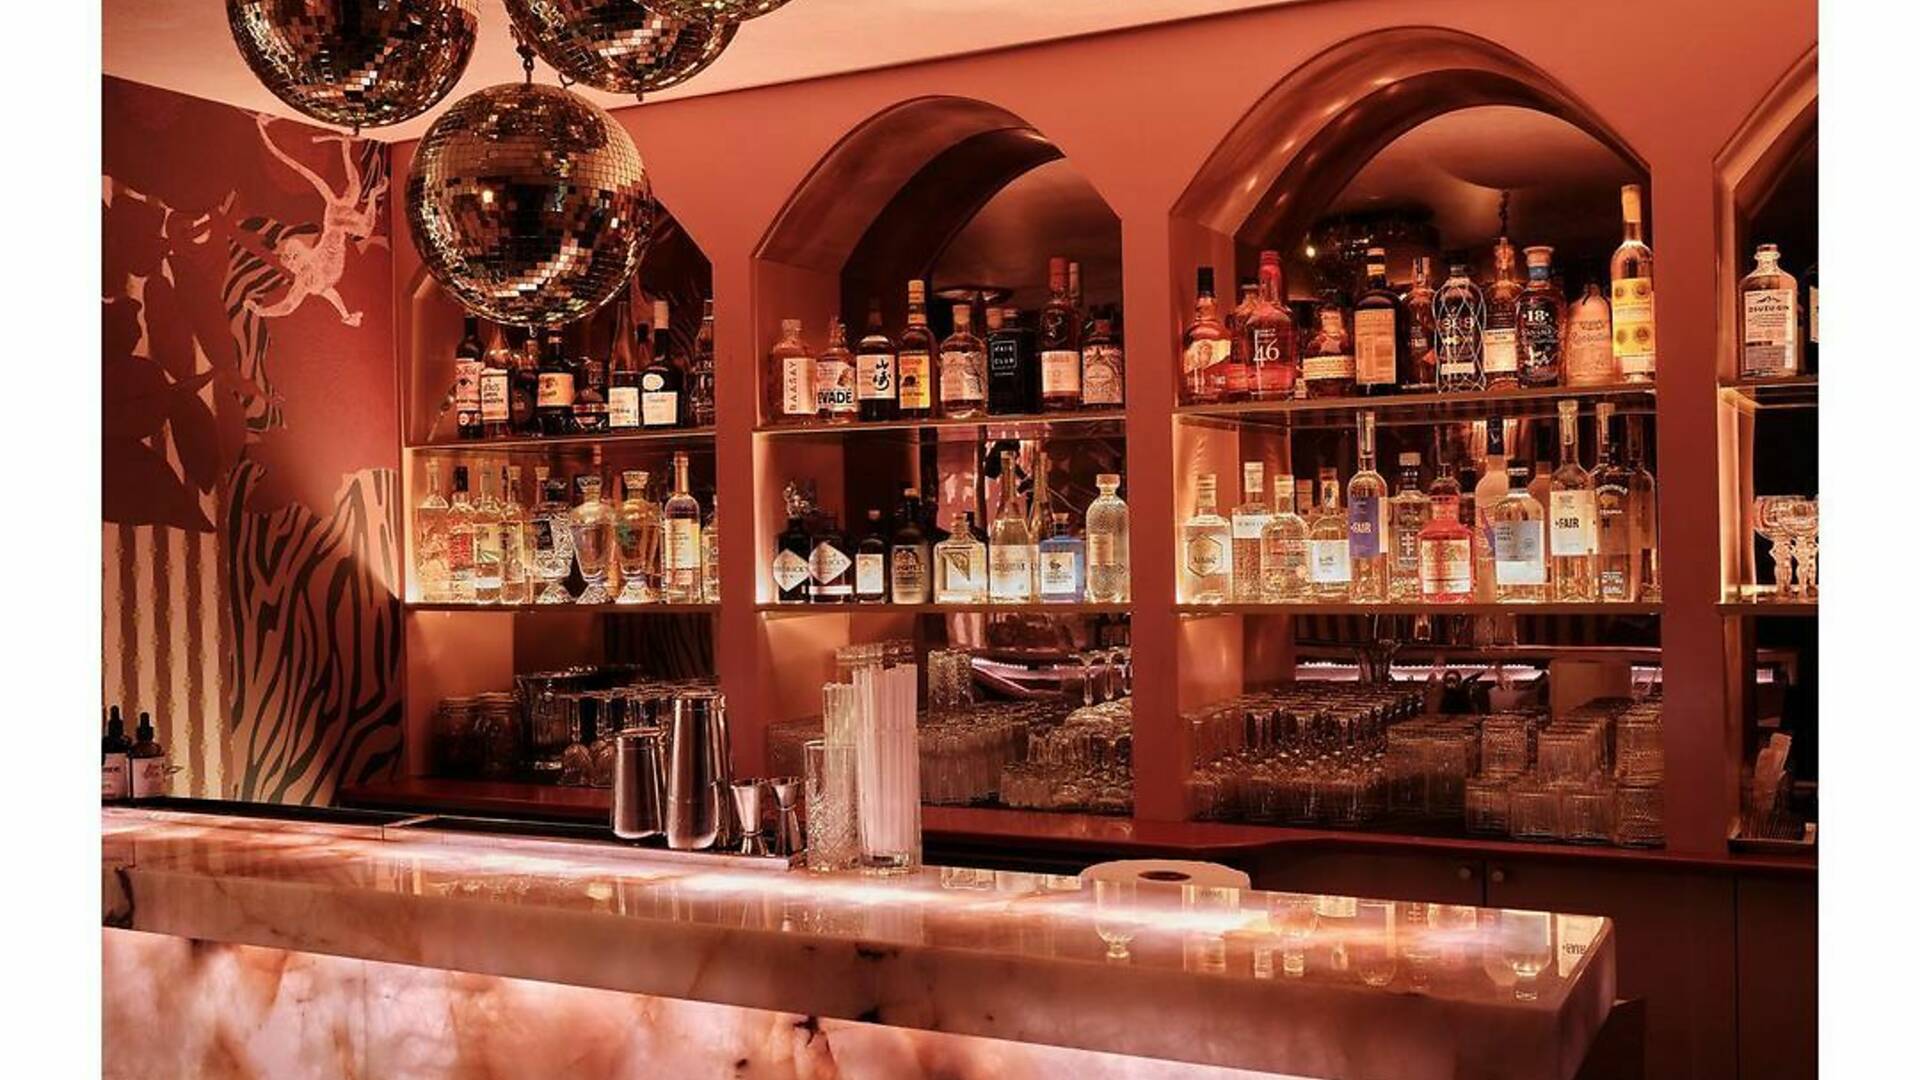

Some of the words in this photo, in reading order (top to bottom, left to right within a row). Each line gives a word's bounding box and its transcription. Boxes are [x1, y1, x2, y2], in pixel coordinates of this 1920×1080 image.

[1527, 309, 1546, 323] 18
[1253, 338, 1280, 361] 46
[1558, 517, 1580, 529] FAIR
